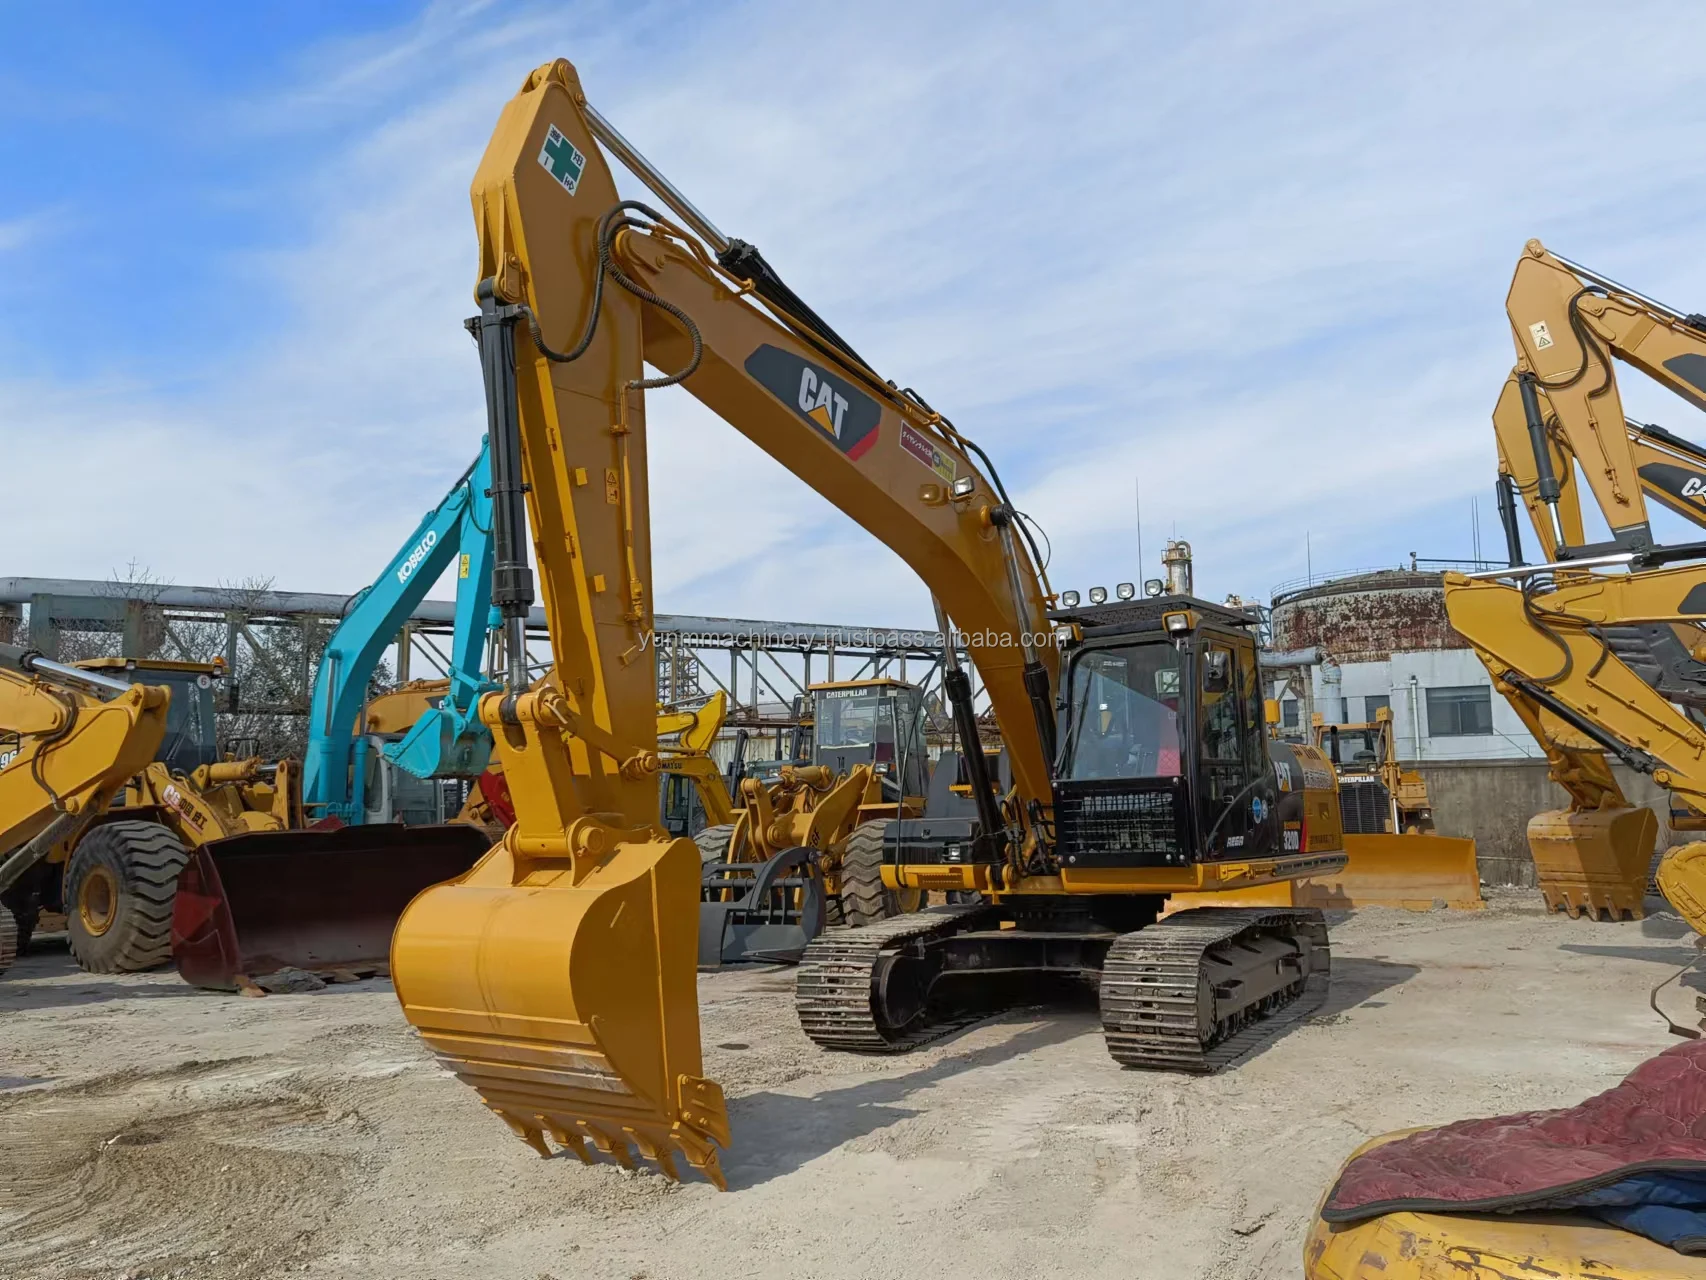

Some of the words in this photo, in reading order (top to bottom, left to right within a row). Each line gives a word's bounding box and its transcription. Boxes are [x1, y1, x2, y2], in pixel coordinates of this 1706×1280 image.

[799, 367, 849, 440] CAT
[397, 530, 437, 584] KOBELCO
[826, 688, 868, 699] CATERPILLAR
[1274, 761, 1293, 792] CAT
[1283, 830, 1299, 850] 320D
